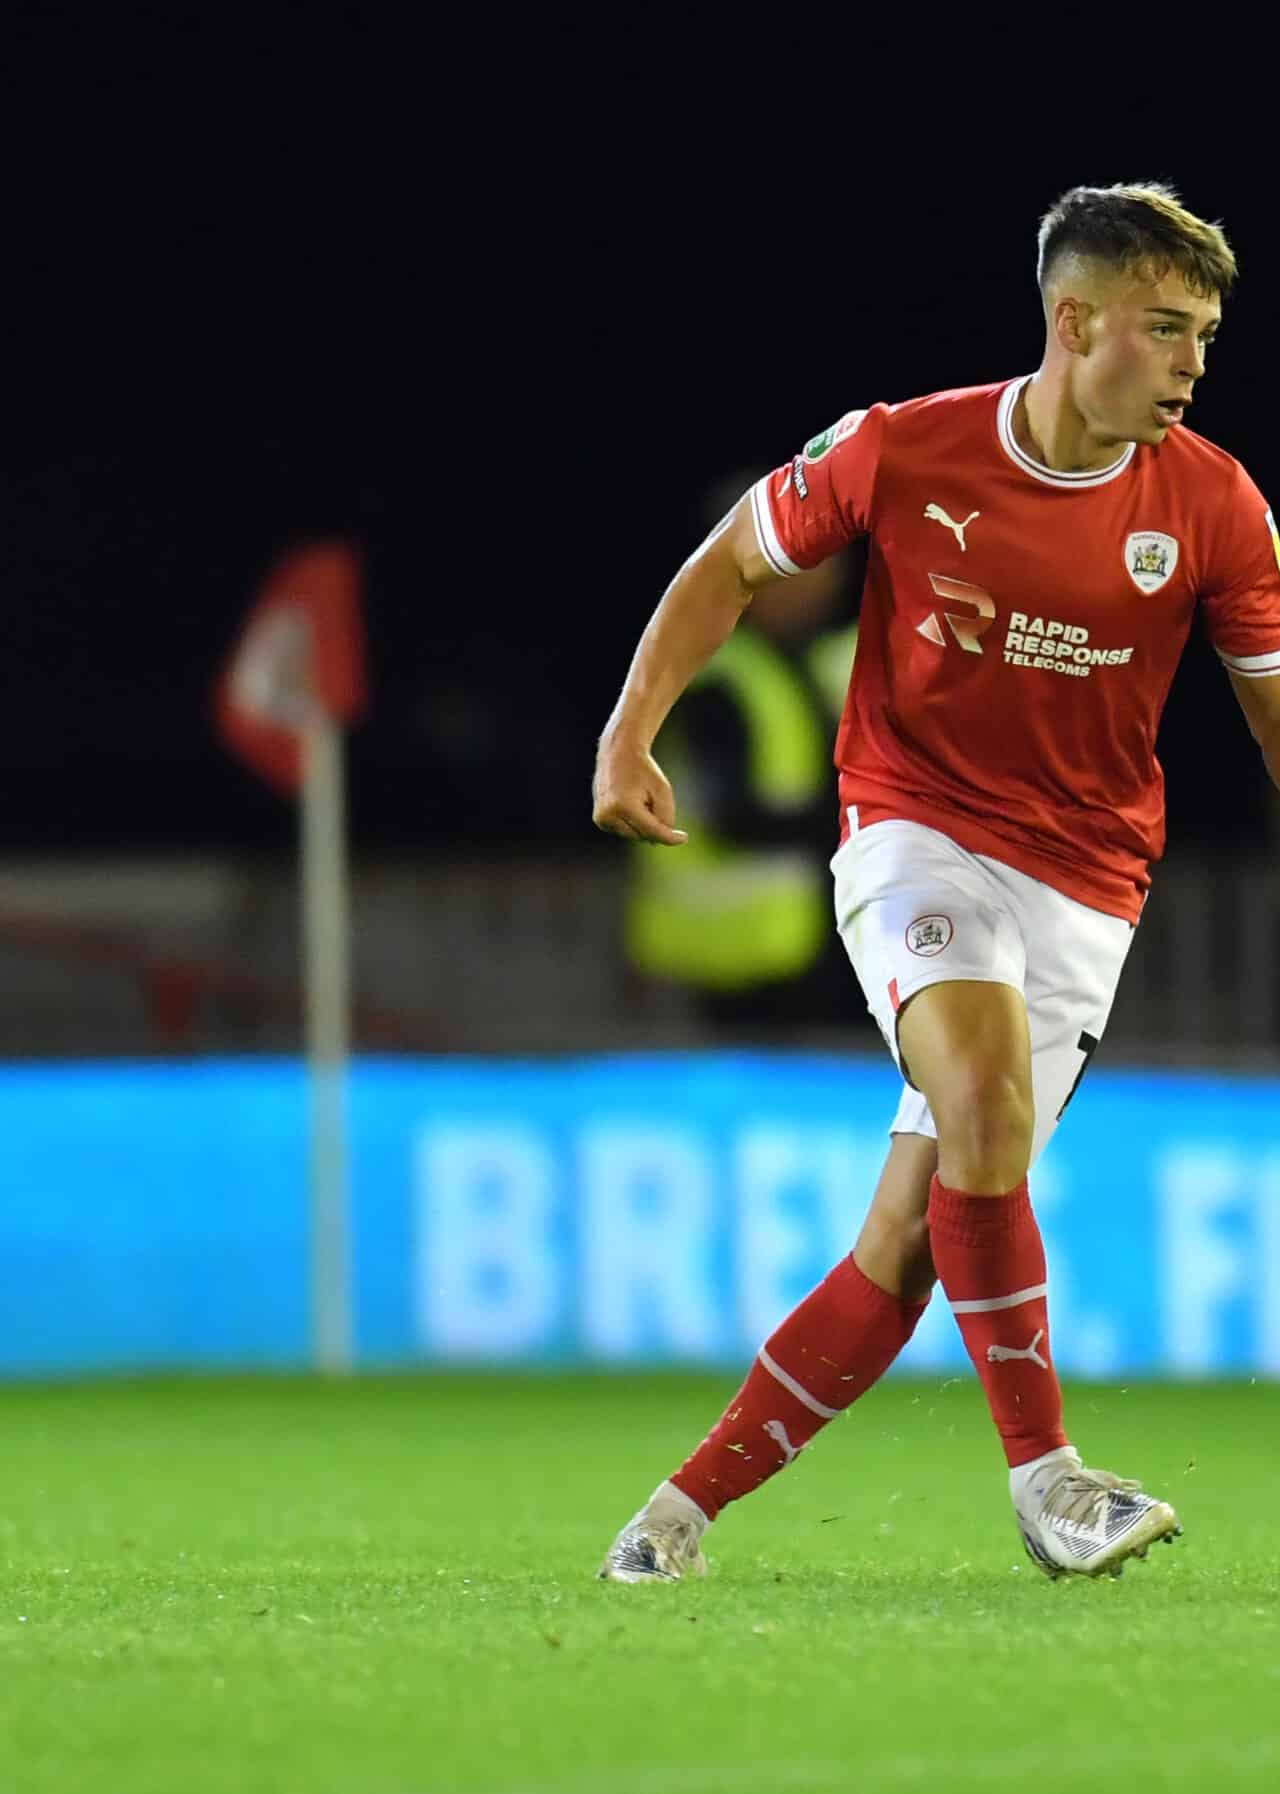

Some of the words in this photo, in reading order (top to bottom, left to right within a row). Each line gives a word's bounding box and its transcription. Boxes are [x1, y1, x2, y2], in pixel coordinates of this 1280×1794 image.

[1008, 611, 1089, 644] RAPID
[1003, 650, 1091, 677] TELECOMS
[1004, 631, 1134, 666] RESPONSE
